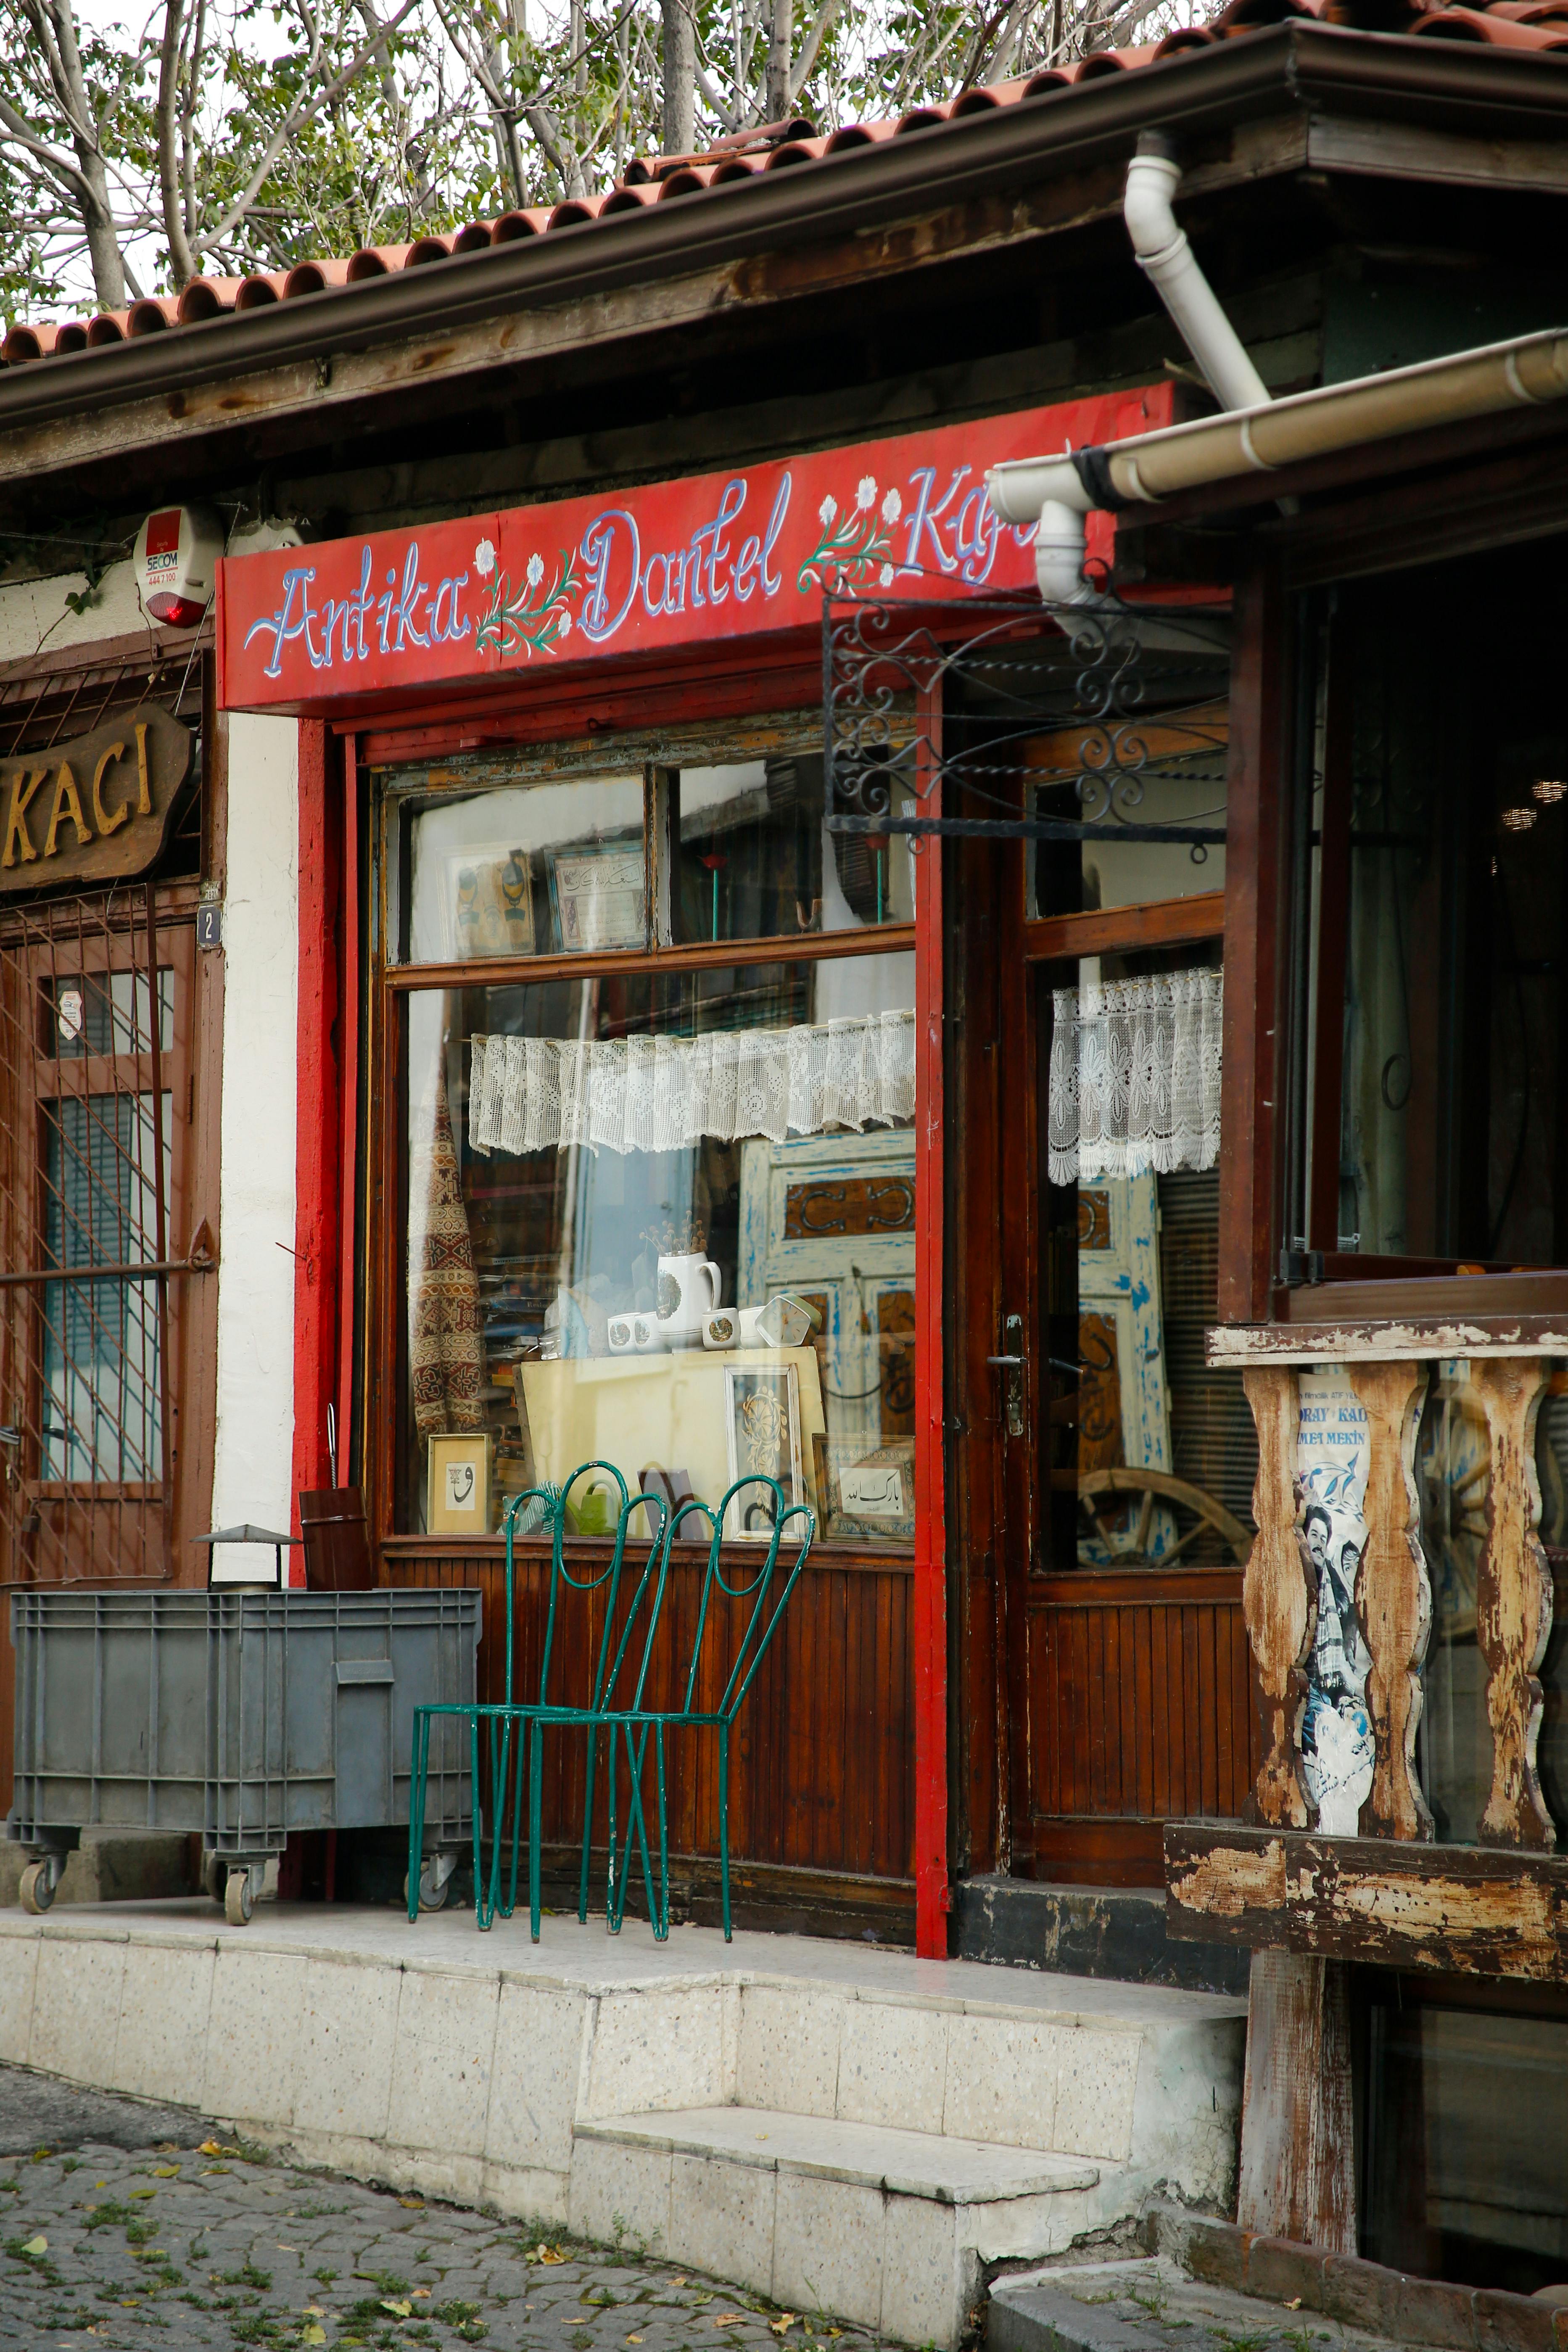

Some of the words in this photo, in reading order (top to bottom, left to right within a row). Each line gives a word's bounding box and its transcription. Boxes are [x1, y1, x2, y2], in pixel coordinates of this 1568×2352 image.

[148, 552, 177, 571] SECOM
[149, 575, 160, 586] 444
[161, 574, 165, 583] 7
[166, 573, 176, 582] 100
[244, 542, 472, 678] Antika
[576, 471, 792, 642] Dantel
[205, 912, 212, 939] 2
[1326, 1430, 1365, 1445] MEKİN
